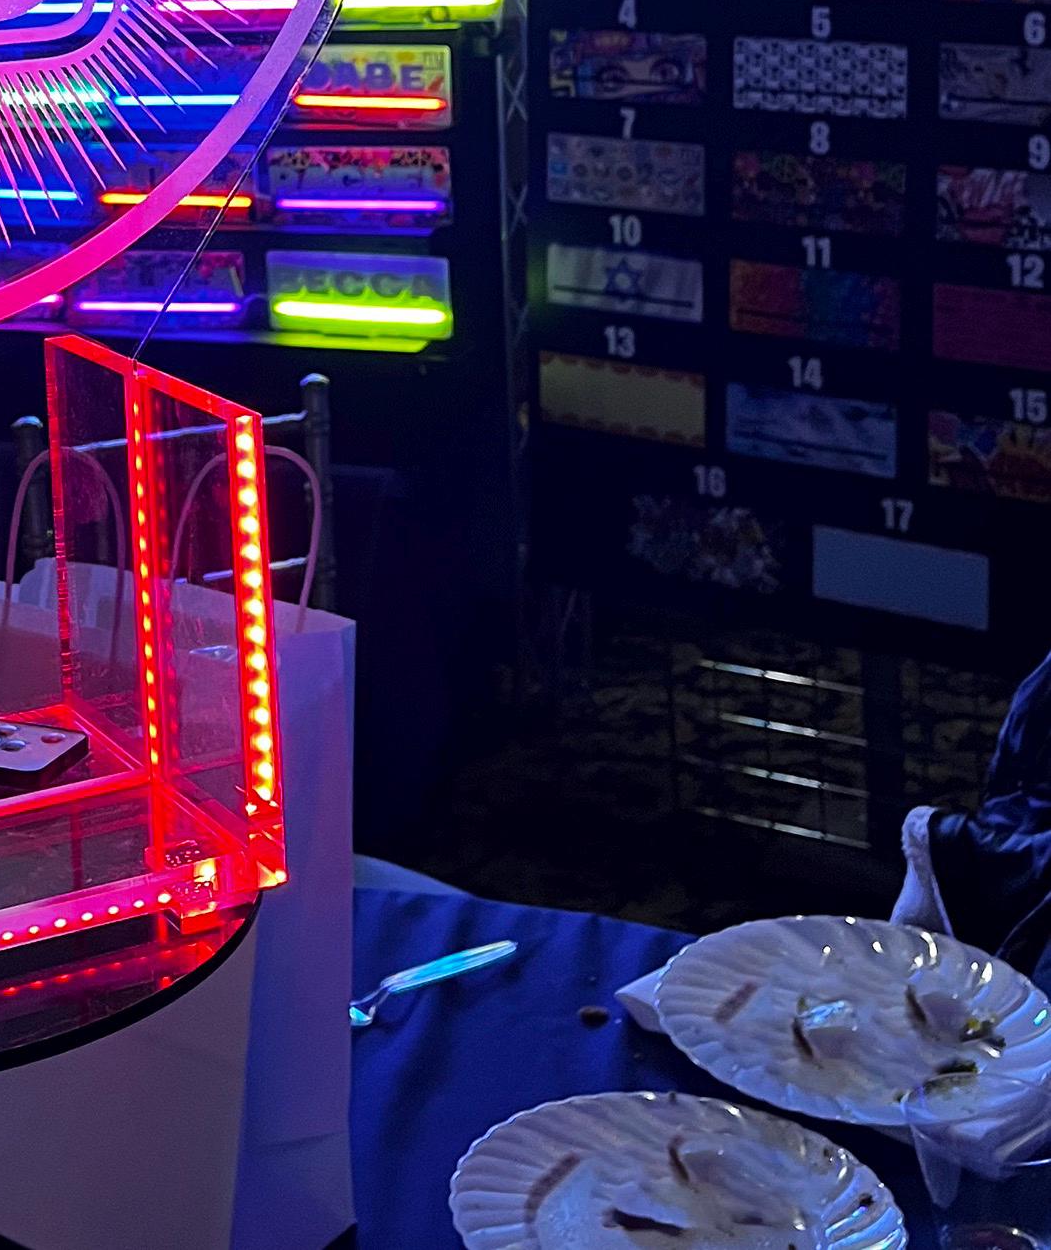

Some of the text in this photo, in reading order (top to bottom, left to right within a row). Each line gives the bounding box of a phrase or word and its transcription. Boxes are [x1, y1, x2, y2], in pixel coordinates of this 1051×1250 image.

[812, 7, 830, 37] 5
[1024, 12, 1045, 45] 6
[621, 108, 635, 138] 7
[810, 122, 829, 154] 8
[1029, 135, 1051, 169] 9
[610, 215, 641, 246] 10
[802, 236, 830, 267] 11
[1007, 254, 1044, 288] 12
[605, 326, 635, 357] 13
[789, 357, 822, 389] 14
[1010, 389, 1047, 422] 15
[882, 499, 913, 531] 17
